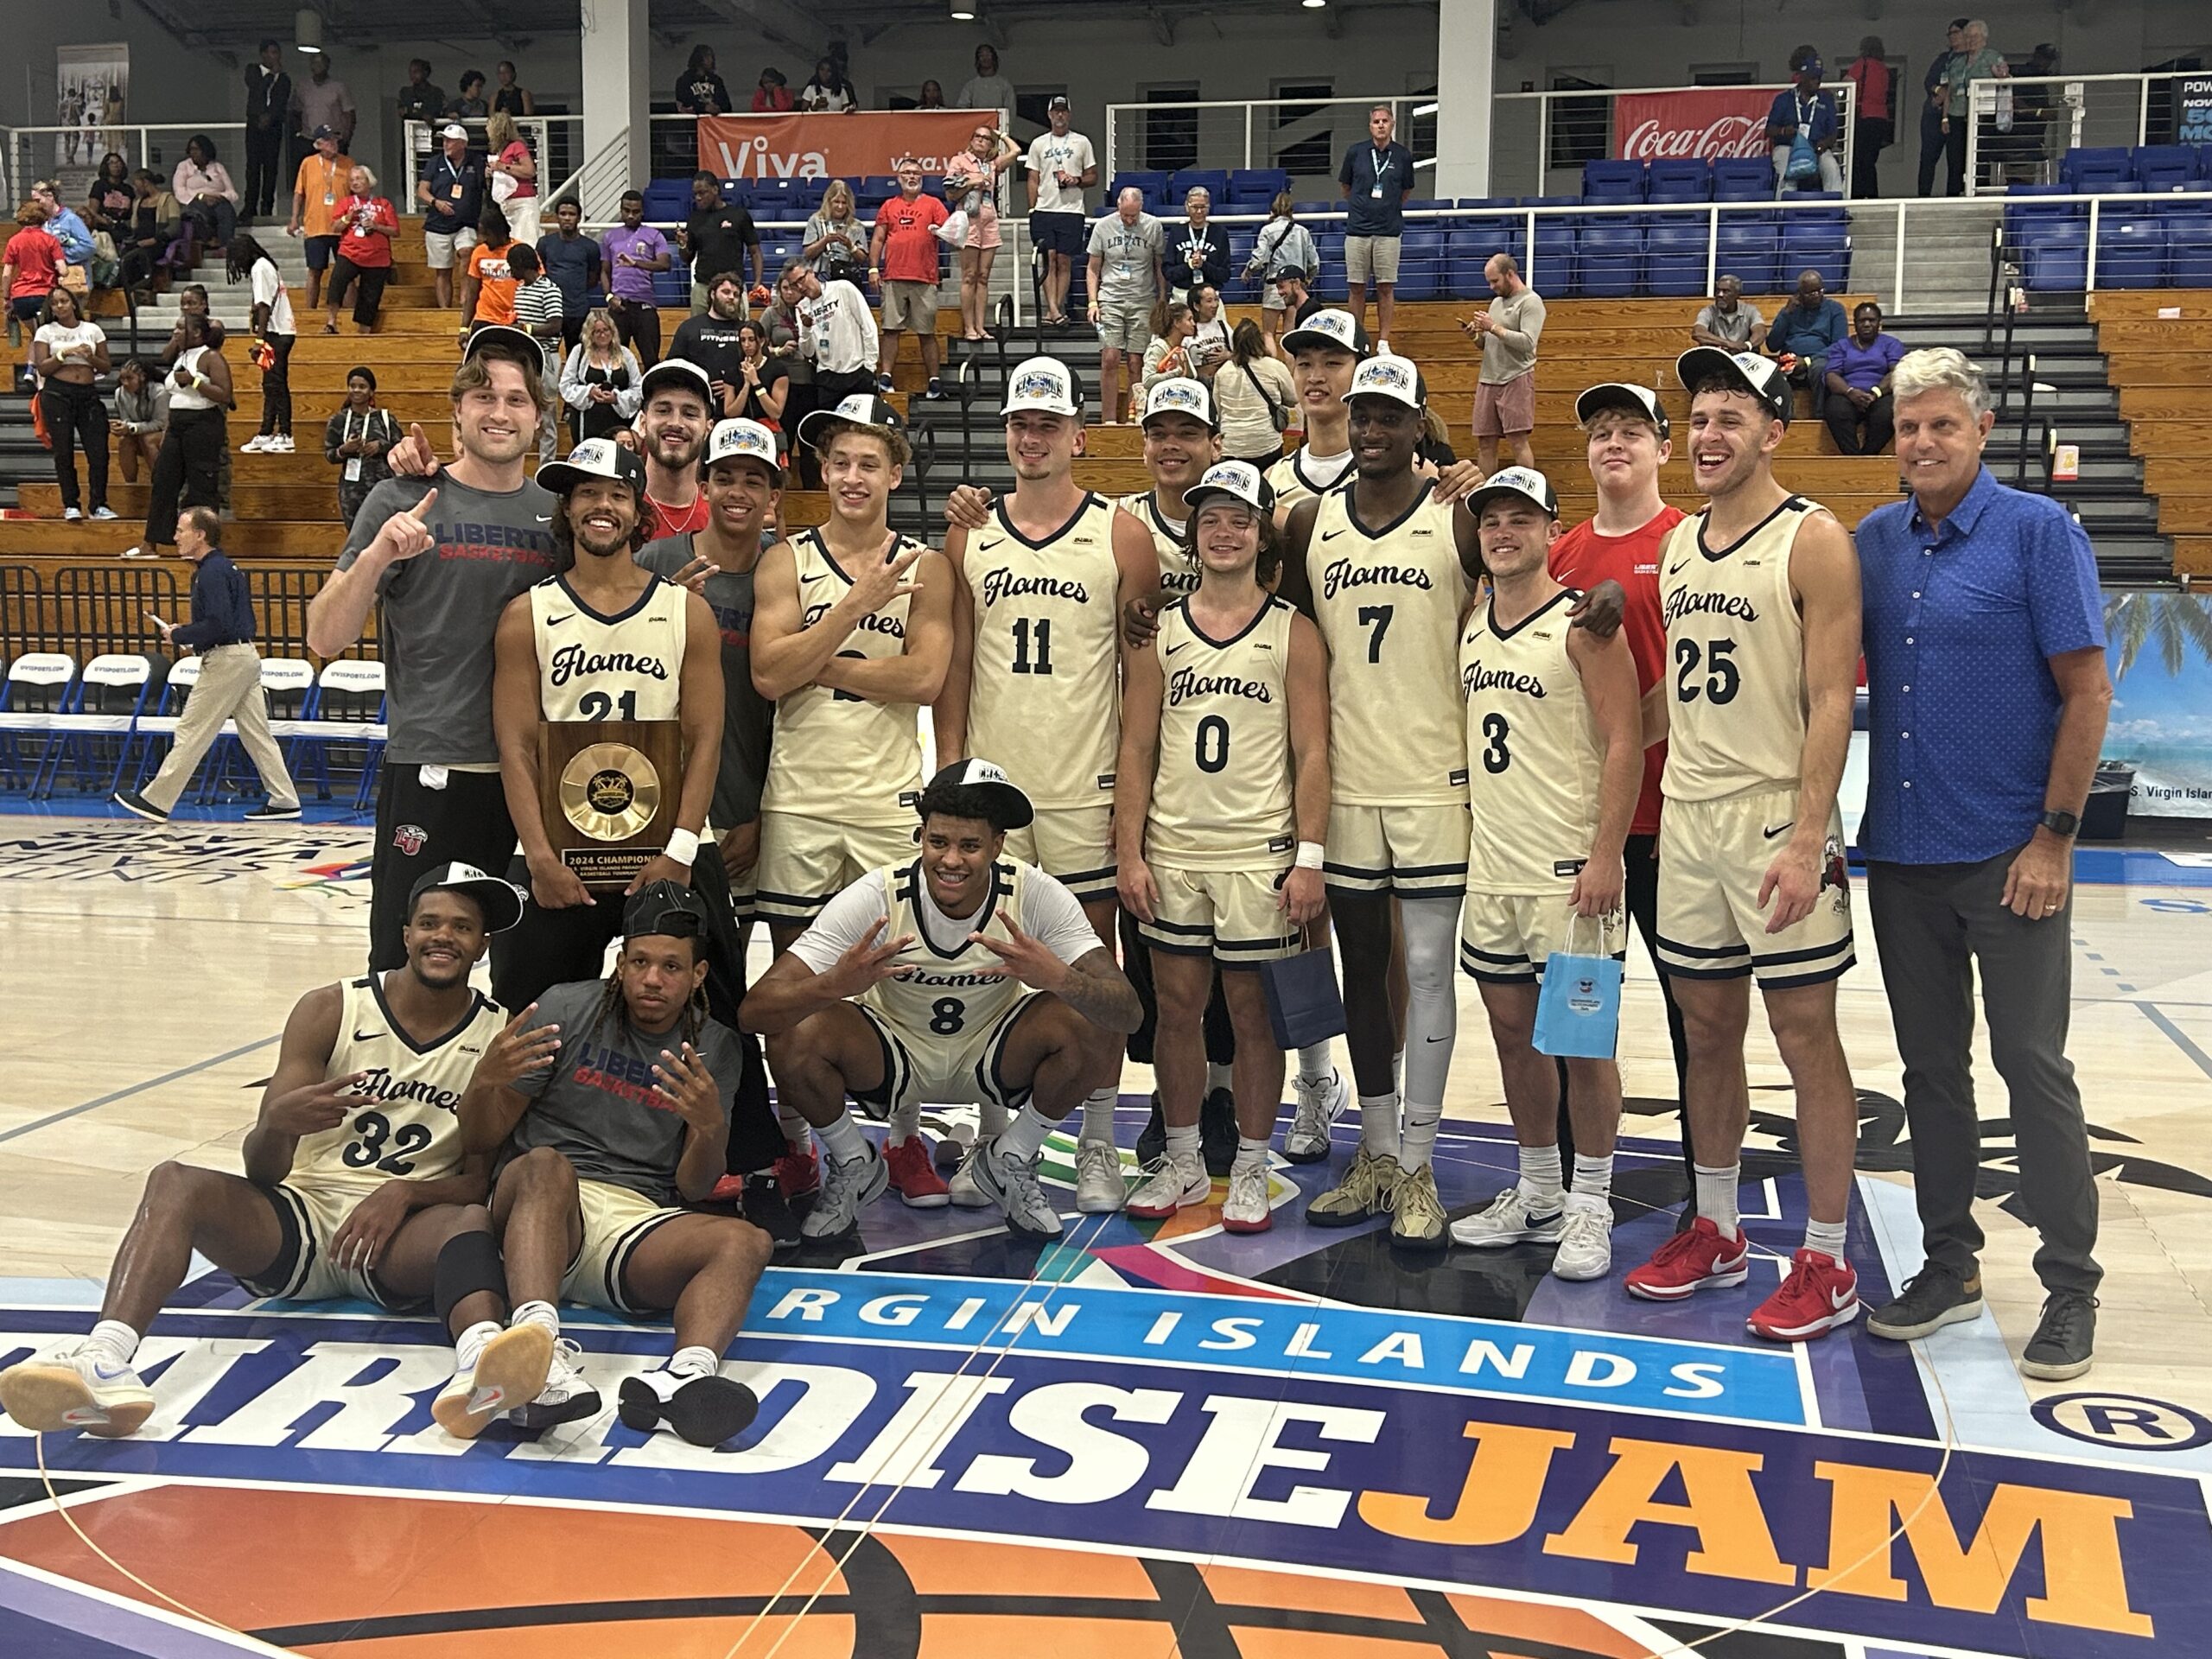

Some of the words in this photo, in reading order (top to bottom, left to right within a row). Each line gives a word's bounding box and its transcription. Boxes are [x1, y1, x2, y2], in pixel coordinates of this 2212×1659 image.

[718, 136, 830, 179] Viva
[1176, 241, 1217, 252] LIBTY
[983, 567, 1090, 607] Flames
[1325, 557, 1433, 601] Flames
[1664, 584, 1759, 632] Flames
[1012, 618, 1052, 675] 11
[1358, 605, 1394, 664] 7
[551, 643, 669, 686] Flames
[1170, 666, 1272, 707] Flames
[1464, 659, 1548, 703] Flames
[1675, 638, 1741, 705] 25
[1195, 715, 1230, 773] 0
[1483, 713, 1511, 774] 3
[2146, 785, 2182, 801] Virgin
[569, 856, 594, 865] 2024
[930, 997, 965, 1035] 8
[342, 1111, 432, 1175] 32
[766, 1288, 1082, 1338] RGIN
[1142, 1312, 1726, 1400] ISLANDS
[1358, 1421, 2155, 1637] JAM
